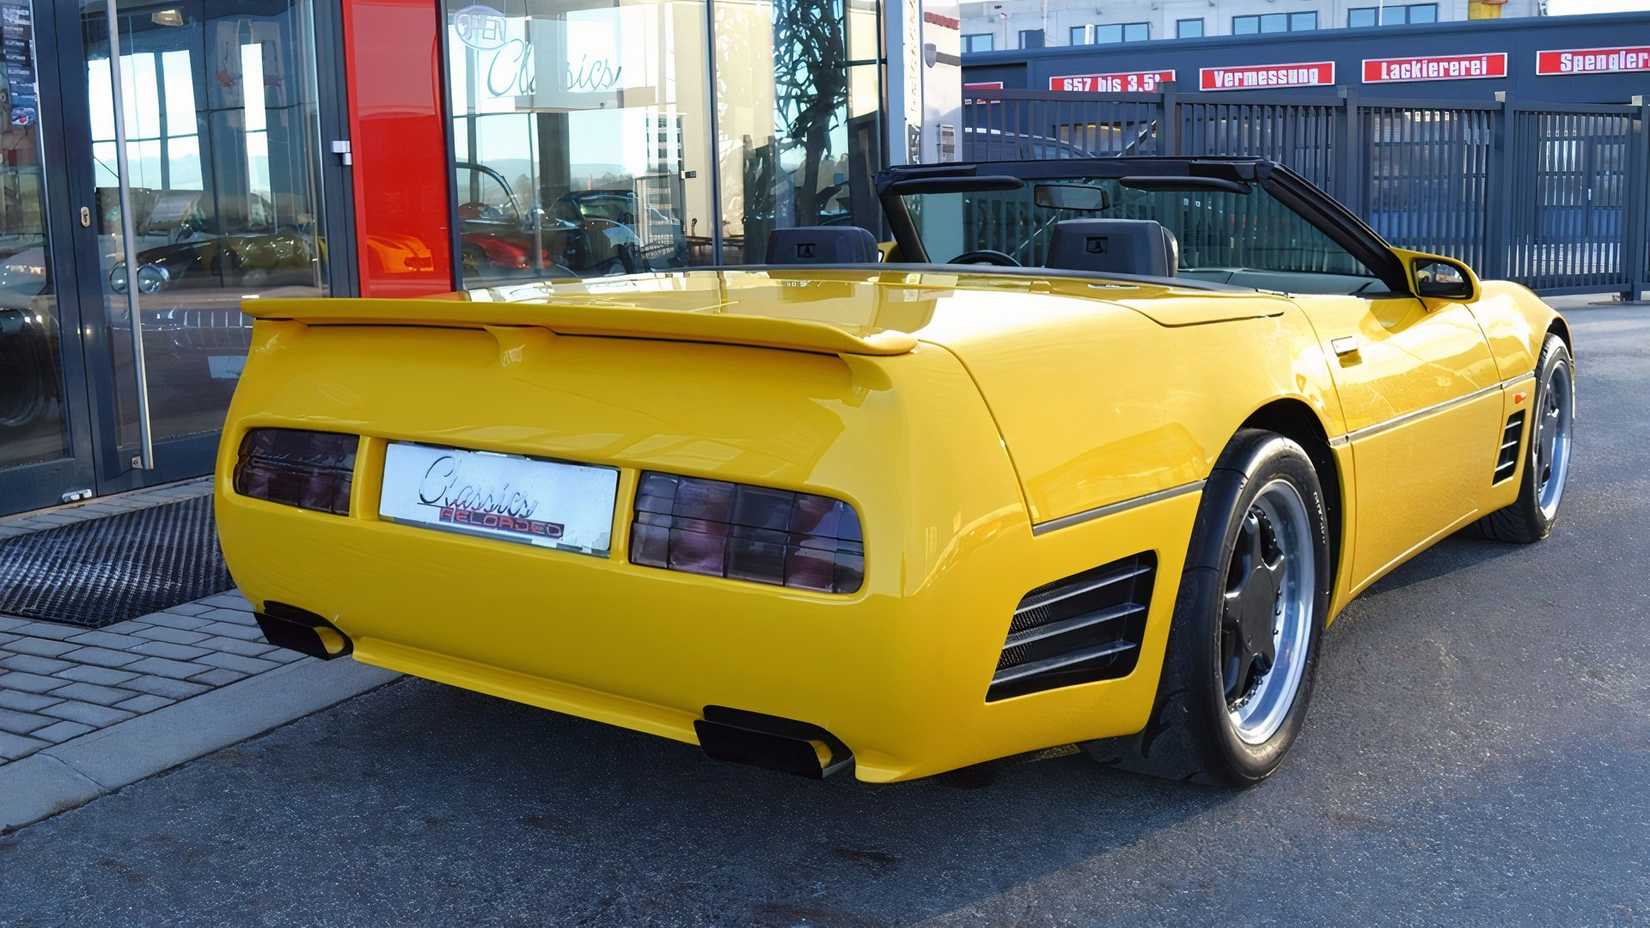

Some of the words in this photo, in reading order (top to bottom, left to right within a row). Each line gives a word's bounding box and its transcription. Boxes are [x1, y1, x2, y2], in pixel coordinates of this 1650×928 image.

[1381, 56, 1488, 80] Lackiererei
[1559, 50, 1650, 73] Spengler
[1097, 76, 1122, 92] bis
[1213, 68, 1319, 88] Vermessung
[416, 455, 538, 518] Classics
[439, 507, 565, 540] RELOADED
